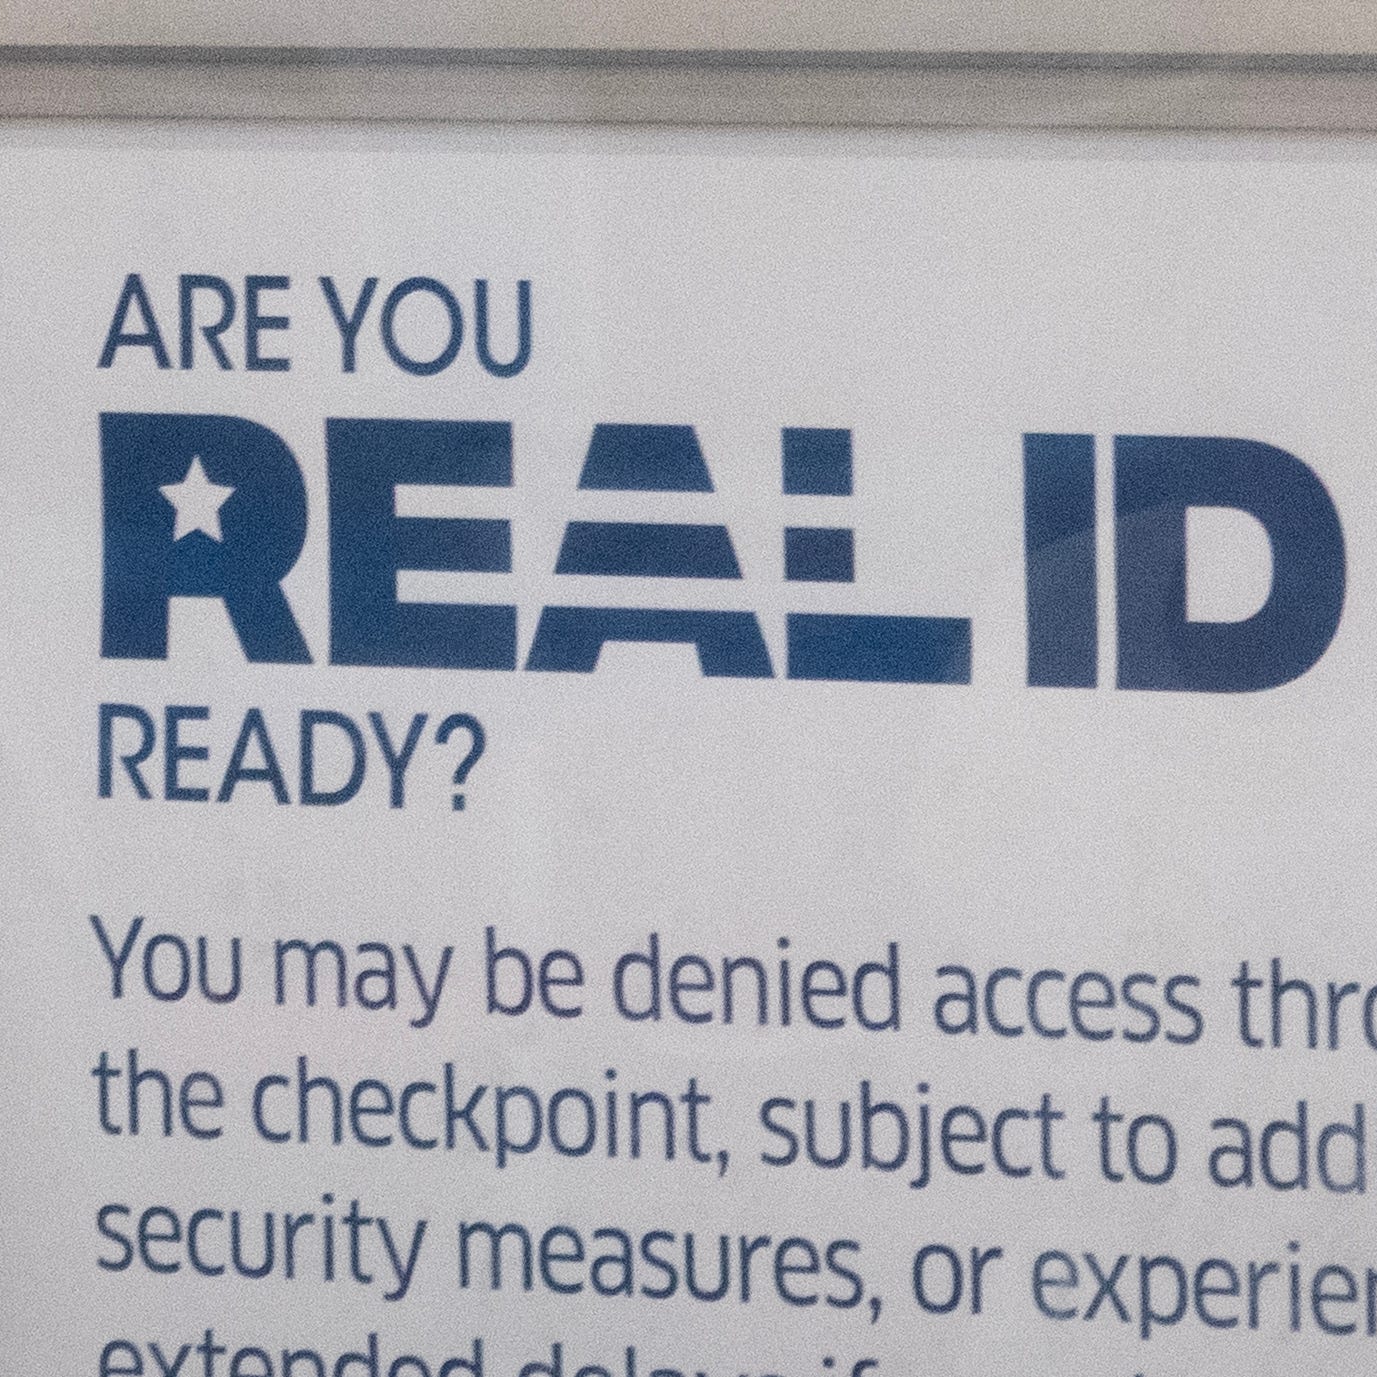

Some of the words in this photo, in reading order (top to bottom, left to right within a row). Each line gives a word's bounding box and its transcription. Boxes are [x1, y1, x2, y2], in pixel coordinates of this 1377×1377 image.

[97, 271, 292, 373] ARE
[318, 275, 533, 380] YOU
[97, 409, 974, 686] REAL
[1021, 431, 1349, 695] ID
[97, 701, 488, 812] READY?
[89, 914, 243, 1006] You
[273, 937, 455, 1030] may
[484, 925, 586, 1020] be
[611, 932, 902, 1033] denied
[932, 963, 1205, 1046] access
[90, 1047, 226, 1142] the
[250, 1054, 731, 1175] checkpoint,
[758, 1079, 1065, 1191] subject
[1091, 1096, 1179, 1187] to
[94, 1191, 429, 1304] security
[456, 1219, 884, 1324] measures,
[910, 1242, 1004, 1316] or
